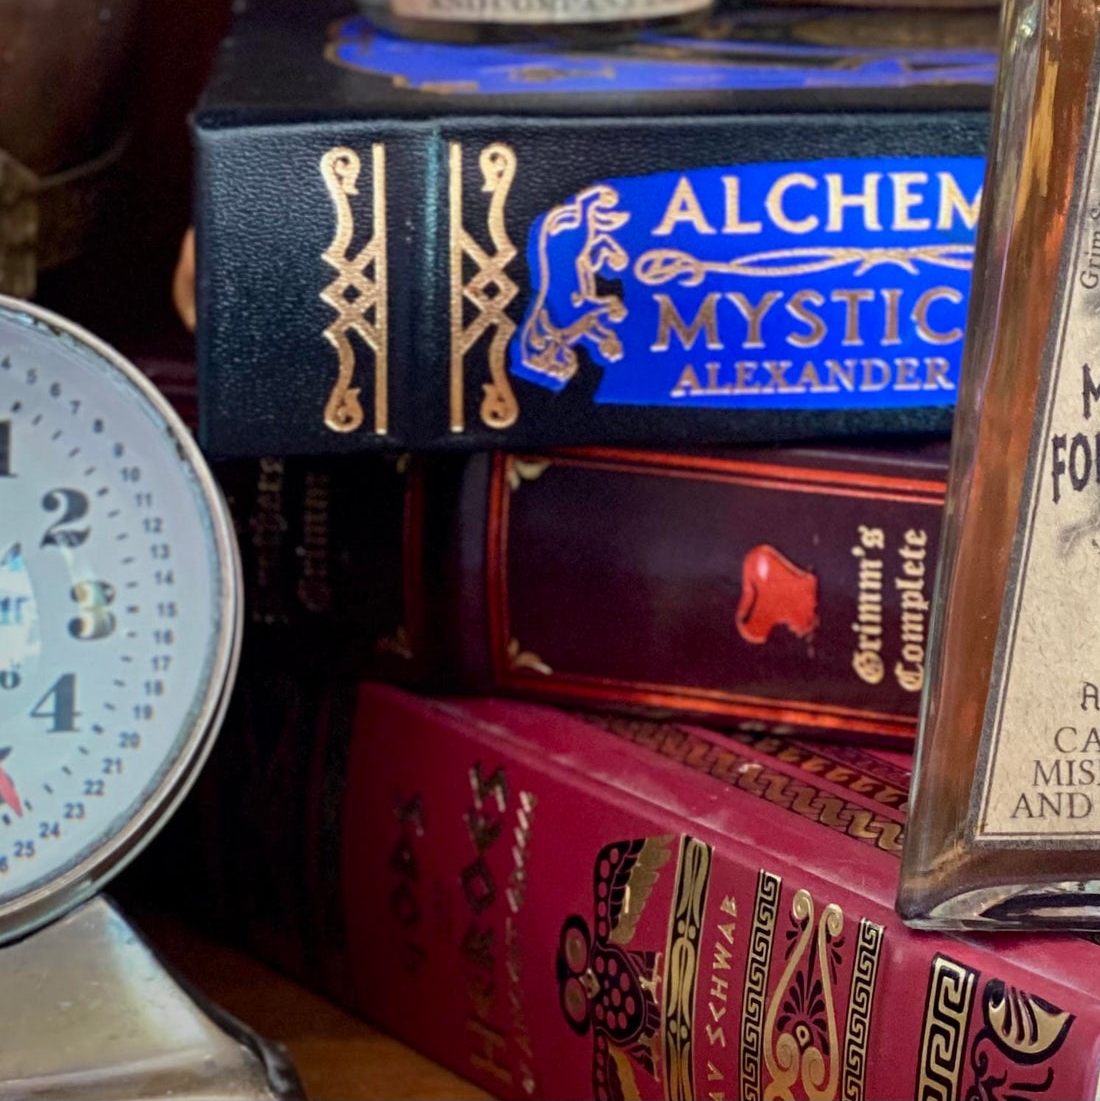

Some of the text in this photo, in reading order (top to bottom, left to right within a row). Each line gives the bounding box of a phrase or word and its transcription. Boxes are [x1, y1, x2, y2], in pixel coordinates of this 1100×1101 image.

[649, 285, 966, 353] MYSTIC
[669, 356, 956, 399] ALEXANDER
[69, 399, 81, 415] 7
[120, 466, 141, 482] 10
[135, 493, 153, 508] 11
[40, 487, 91, 549] 2
[142, 517, 163, 534] 12
[149, 543, 170, 560] 13
[154, 570, 175, 586] 14
[67, 580, 117, 641] 3
[156, 601, 177, 619] 15
[850, 524, 886, 686] Grimm's
[893, 527, 930, 693] Complete
[153, 628, 175, 645] 16
[151, 655, 173, 672] 17
[143, 680, 164, 697] 18
[1080, 681, 1100, 711] A
[30, 672, 82, 734] 4
[133, 704, 153, 721] 19
[118, 731, 141, 749] 20
[102, 757, 123, 775] 21
[83, 778, 105, 797] 22
[63, 801, 86, 820] 23
[1009, 791, 1092, 820] AND
[38, 820, 61, 839] 24
[13, 839, 36, 858] 25
[704, 894, 738, 1049] SCHWAB
